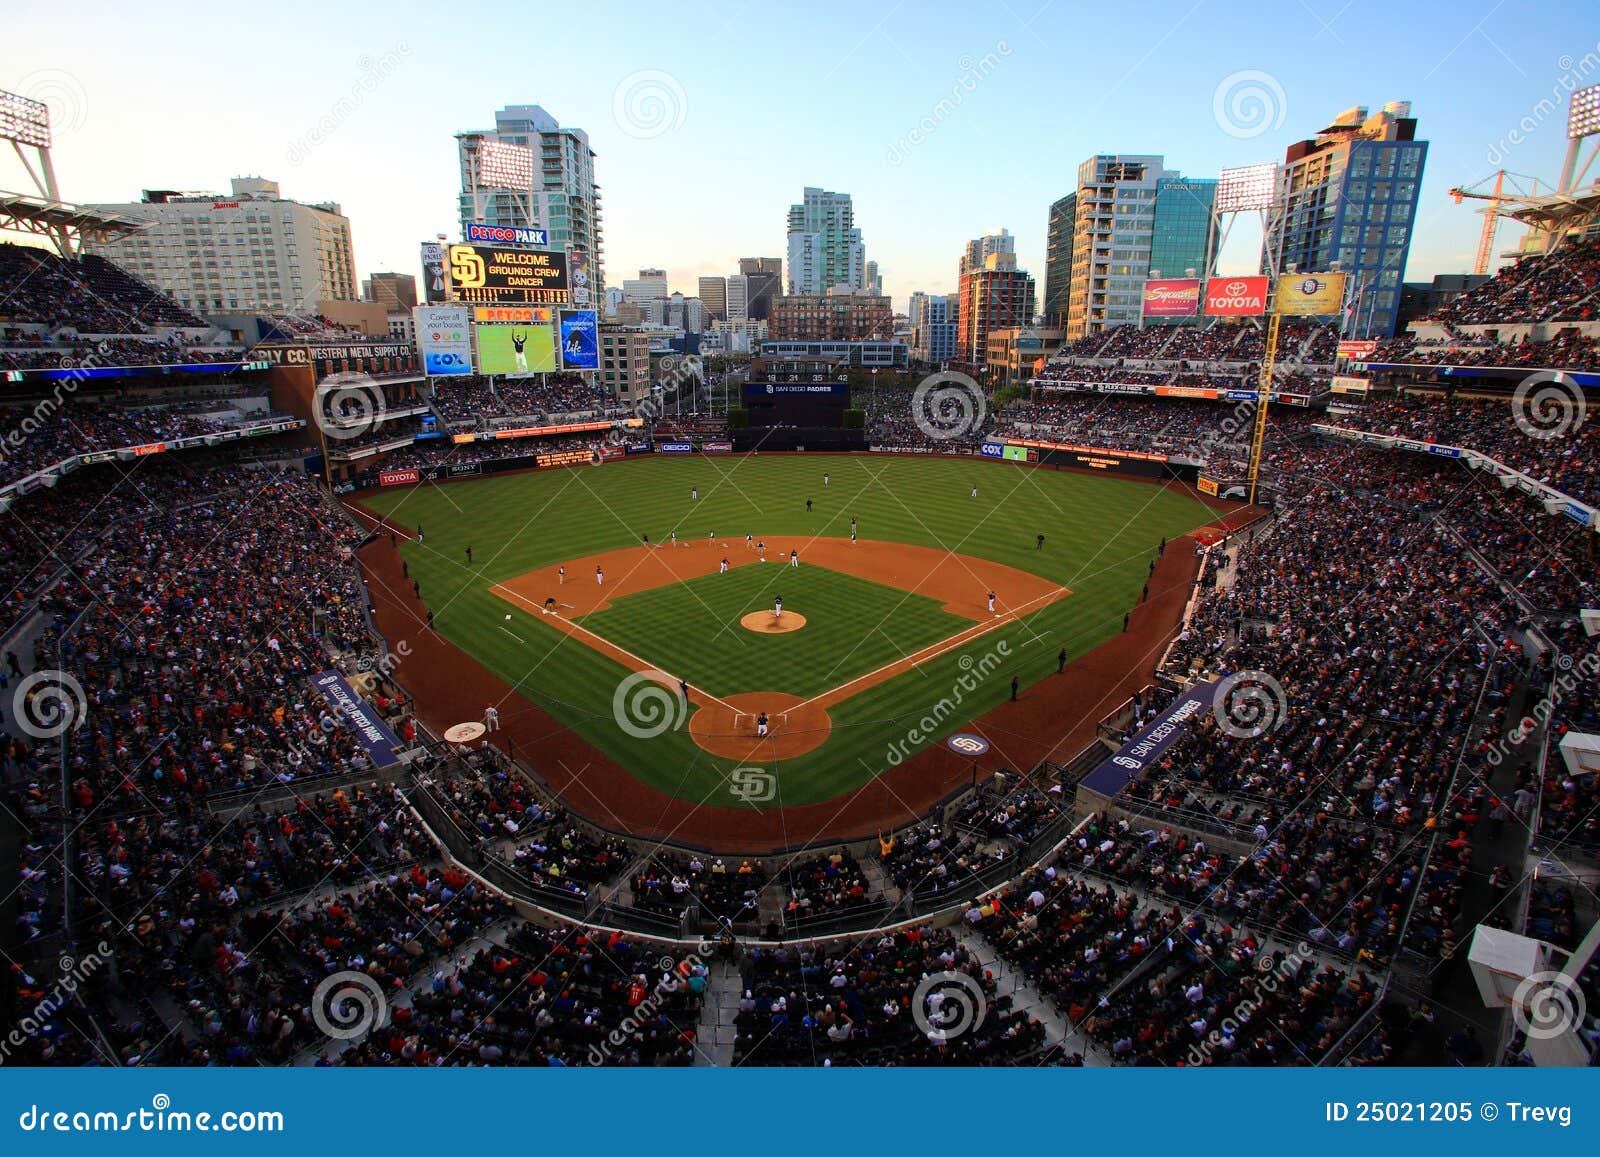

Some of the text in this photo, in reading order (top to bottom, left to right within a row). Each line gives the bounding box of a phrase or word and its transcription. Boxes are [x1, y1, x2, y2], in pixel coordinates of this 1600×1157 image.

[471, 226, 544, 244] PETCO PARK
[494, 252, 549, 265] WELCOME
[488, 265, 560, 277] GROUNDS CREW
[508, 277, 543, 286] DANCER
[1208, 297, 1261, 309] TOYOTA
[311, 346, 411, 360] WESTERN METAL SUPPLY CO.
[432, 354, 465, 366] COX
[788, 374, 799, 382] 31
[812, 374, 823, 382] 35
[838, 374, 848, 382] 42
[982, 444, 1002, 455] COX
[383, 473, 416, 483] TOYOTA
[350, 708, 370, 728] PETCO
[363, 725, 384, 743] PARK
[1130, 741, 1156, 757] SAN
[1147, 722, 1176, 743] DIEGO
[1167, 699, 1202, 723] PADRES
